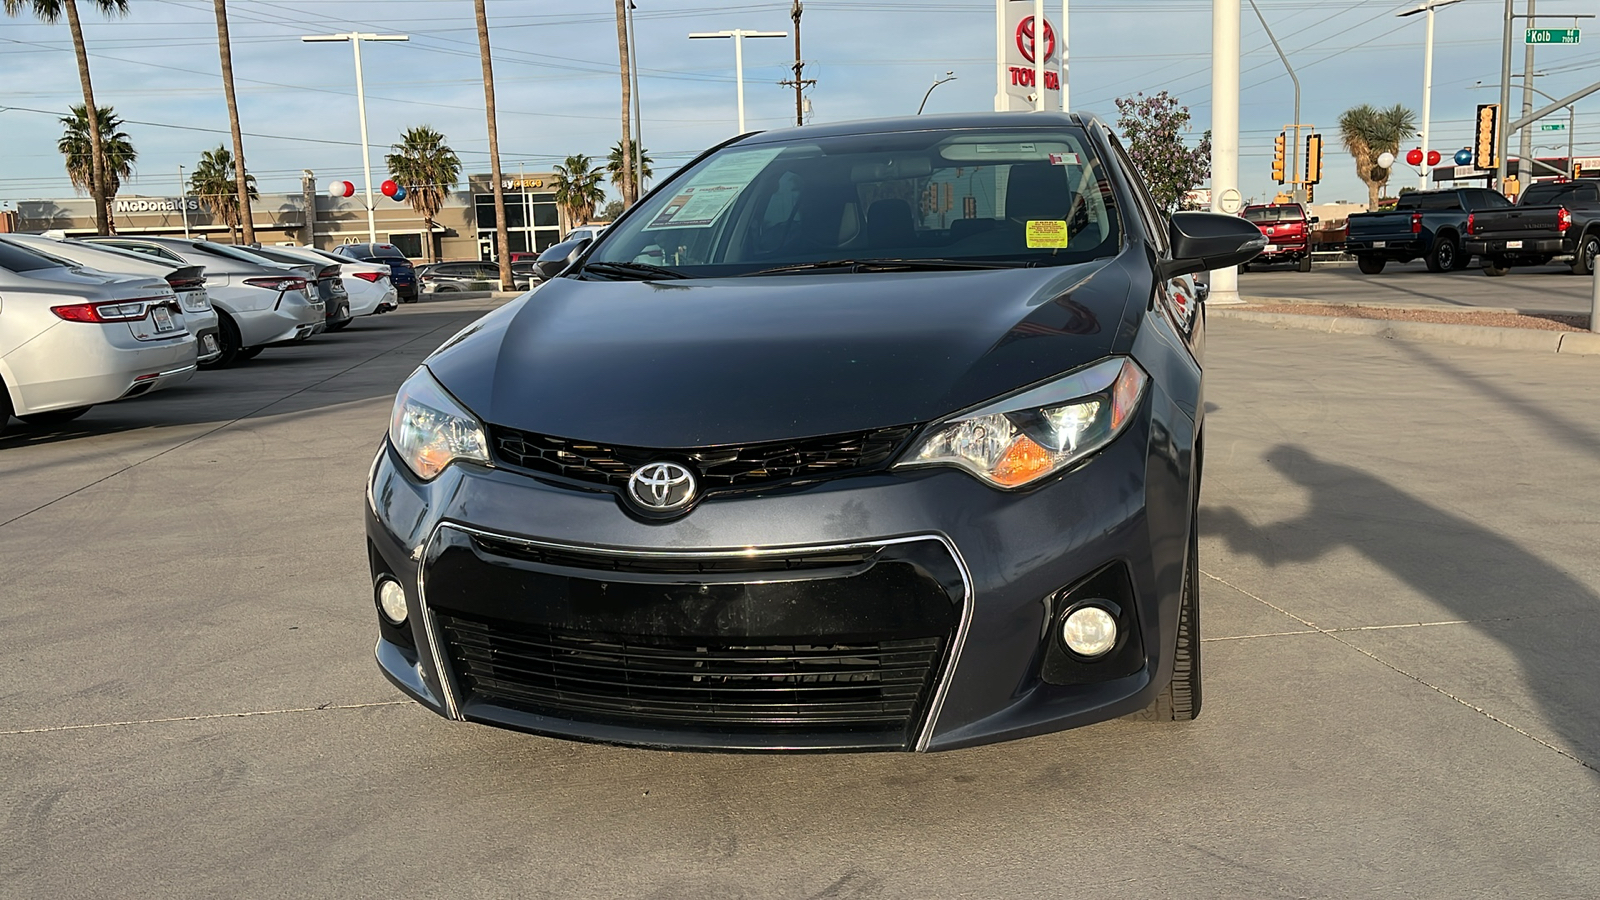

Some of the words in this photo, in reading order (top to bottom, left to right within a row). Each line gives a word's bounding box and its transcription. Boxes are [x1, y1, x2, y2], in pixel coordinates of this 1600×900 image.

[1531, 30, 1551, 42] Kolb
[1008, 66, 1060, 90] TOYTA
[116, 200, 198, 212] McDonald's
